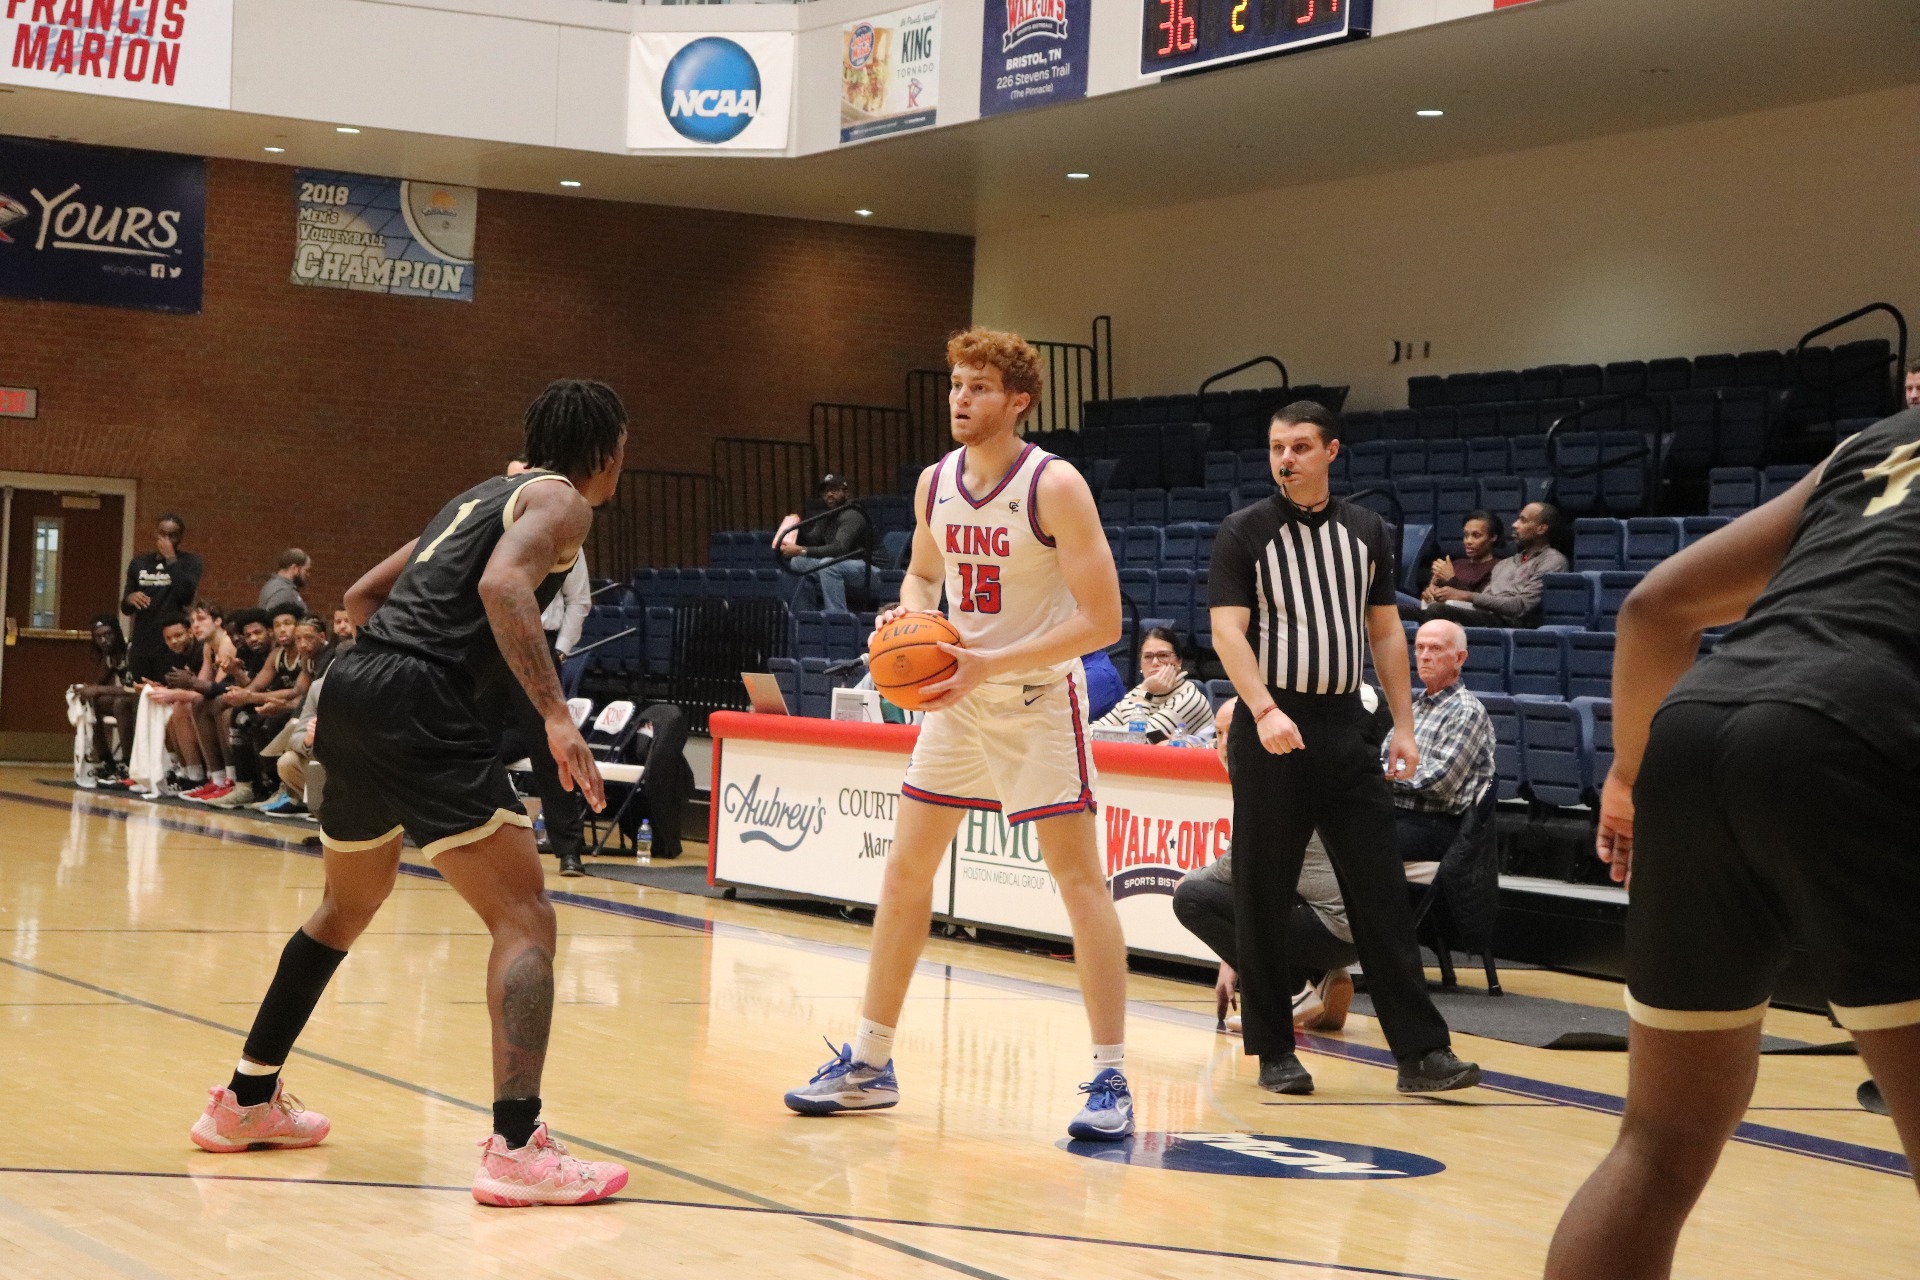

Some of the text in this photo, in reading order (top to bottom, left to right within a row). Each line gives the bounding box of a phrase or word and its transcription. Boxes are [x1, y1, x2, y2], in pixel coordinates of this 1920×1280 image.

[1158, 0, 1195, 54] 36
[12, 23, 181, 86] MARION
[901, 25, 932, 64] KING
[897, 62, 935, 79] TORNADO
[1005, 48, 1062, 71] BRISTOL, TN
[996, 63, 1071, 90] 226 Stevens Trail
[669, 89, 759, 118] NCAA
[300, 182, 350, 206] 2018
[30, 183, 181, 250] YOURS
[300, 207, 340, 225] MEN'S
[299, 223, 387, 248] VOLLEYBALL
[295, 243, 465, 293] CHAMPION
[414, 498, 482, 564] 1
[945, 523, 1010, 557] KING
[958, 562, 1002, 614] 15
[882, 624, 919, 641] EVO
[724, 774, 826, 852] Aubrey's
[858, 830, 893, 859] Marr
[963, 866, 1046, 890] HOLSTON MEDICAL GROUP
[1124, 876, 1177, 889] SPORTS BIST
